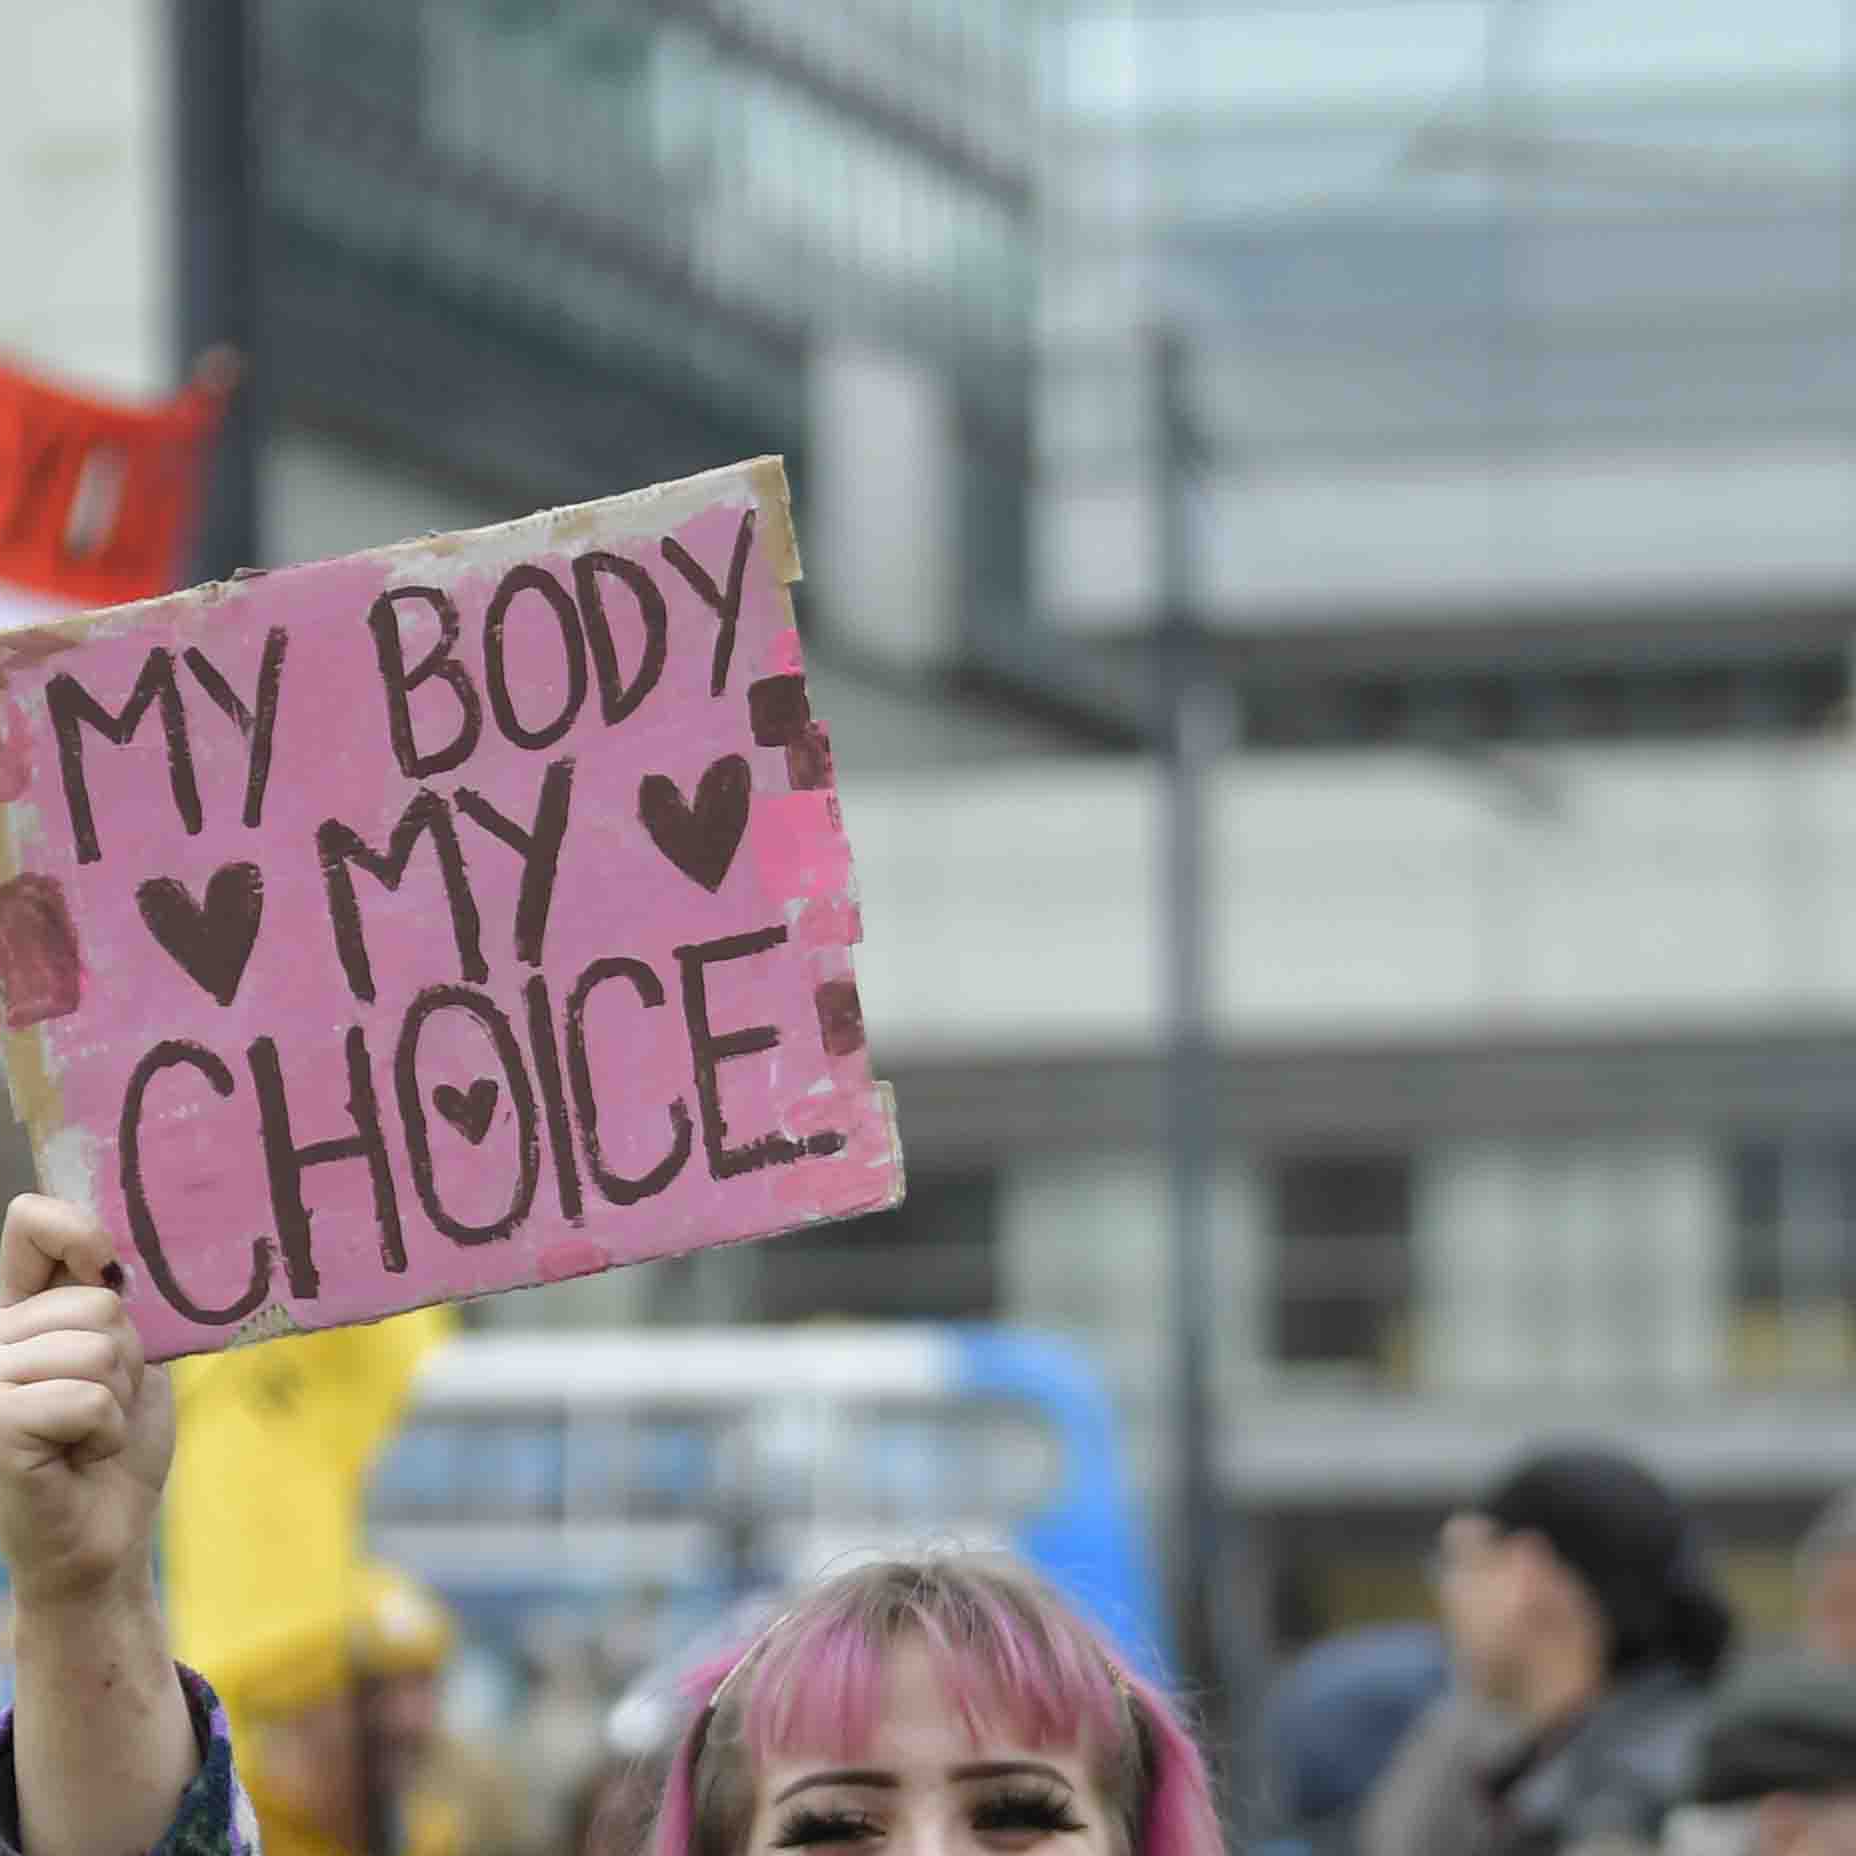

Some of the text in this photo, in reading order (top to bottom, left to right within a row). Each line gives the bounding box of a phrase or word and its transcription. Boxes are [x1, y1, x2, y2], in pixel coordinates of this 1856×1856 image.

[45, 508, 756, 865] MY BODY
[316, 757, 575, 1003] MY
[118, 926, 846, 1325] CHOICE
